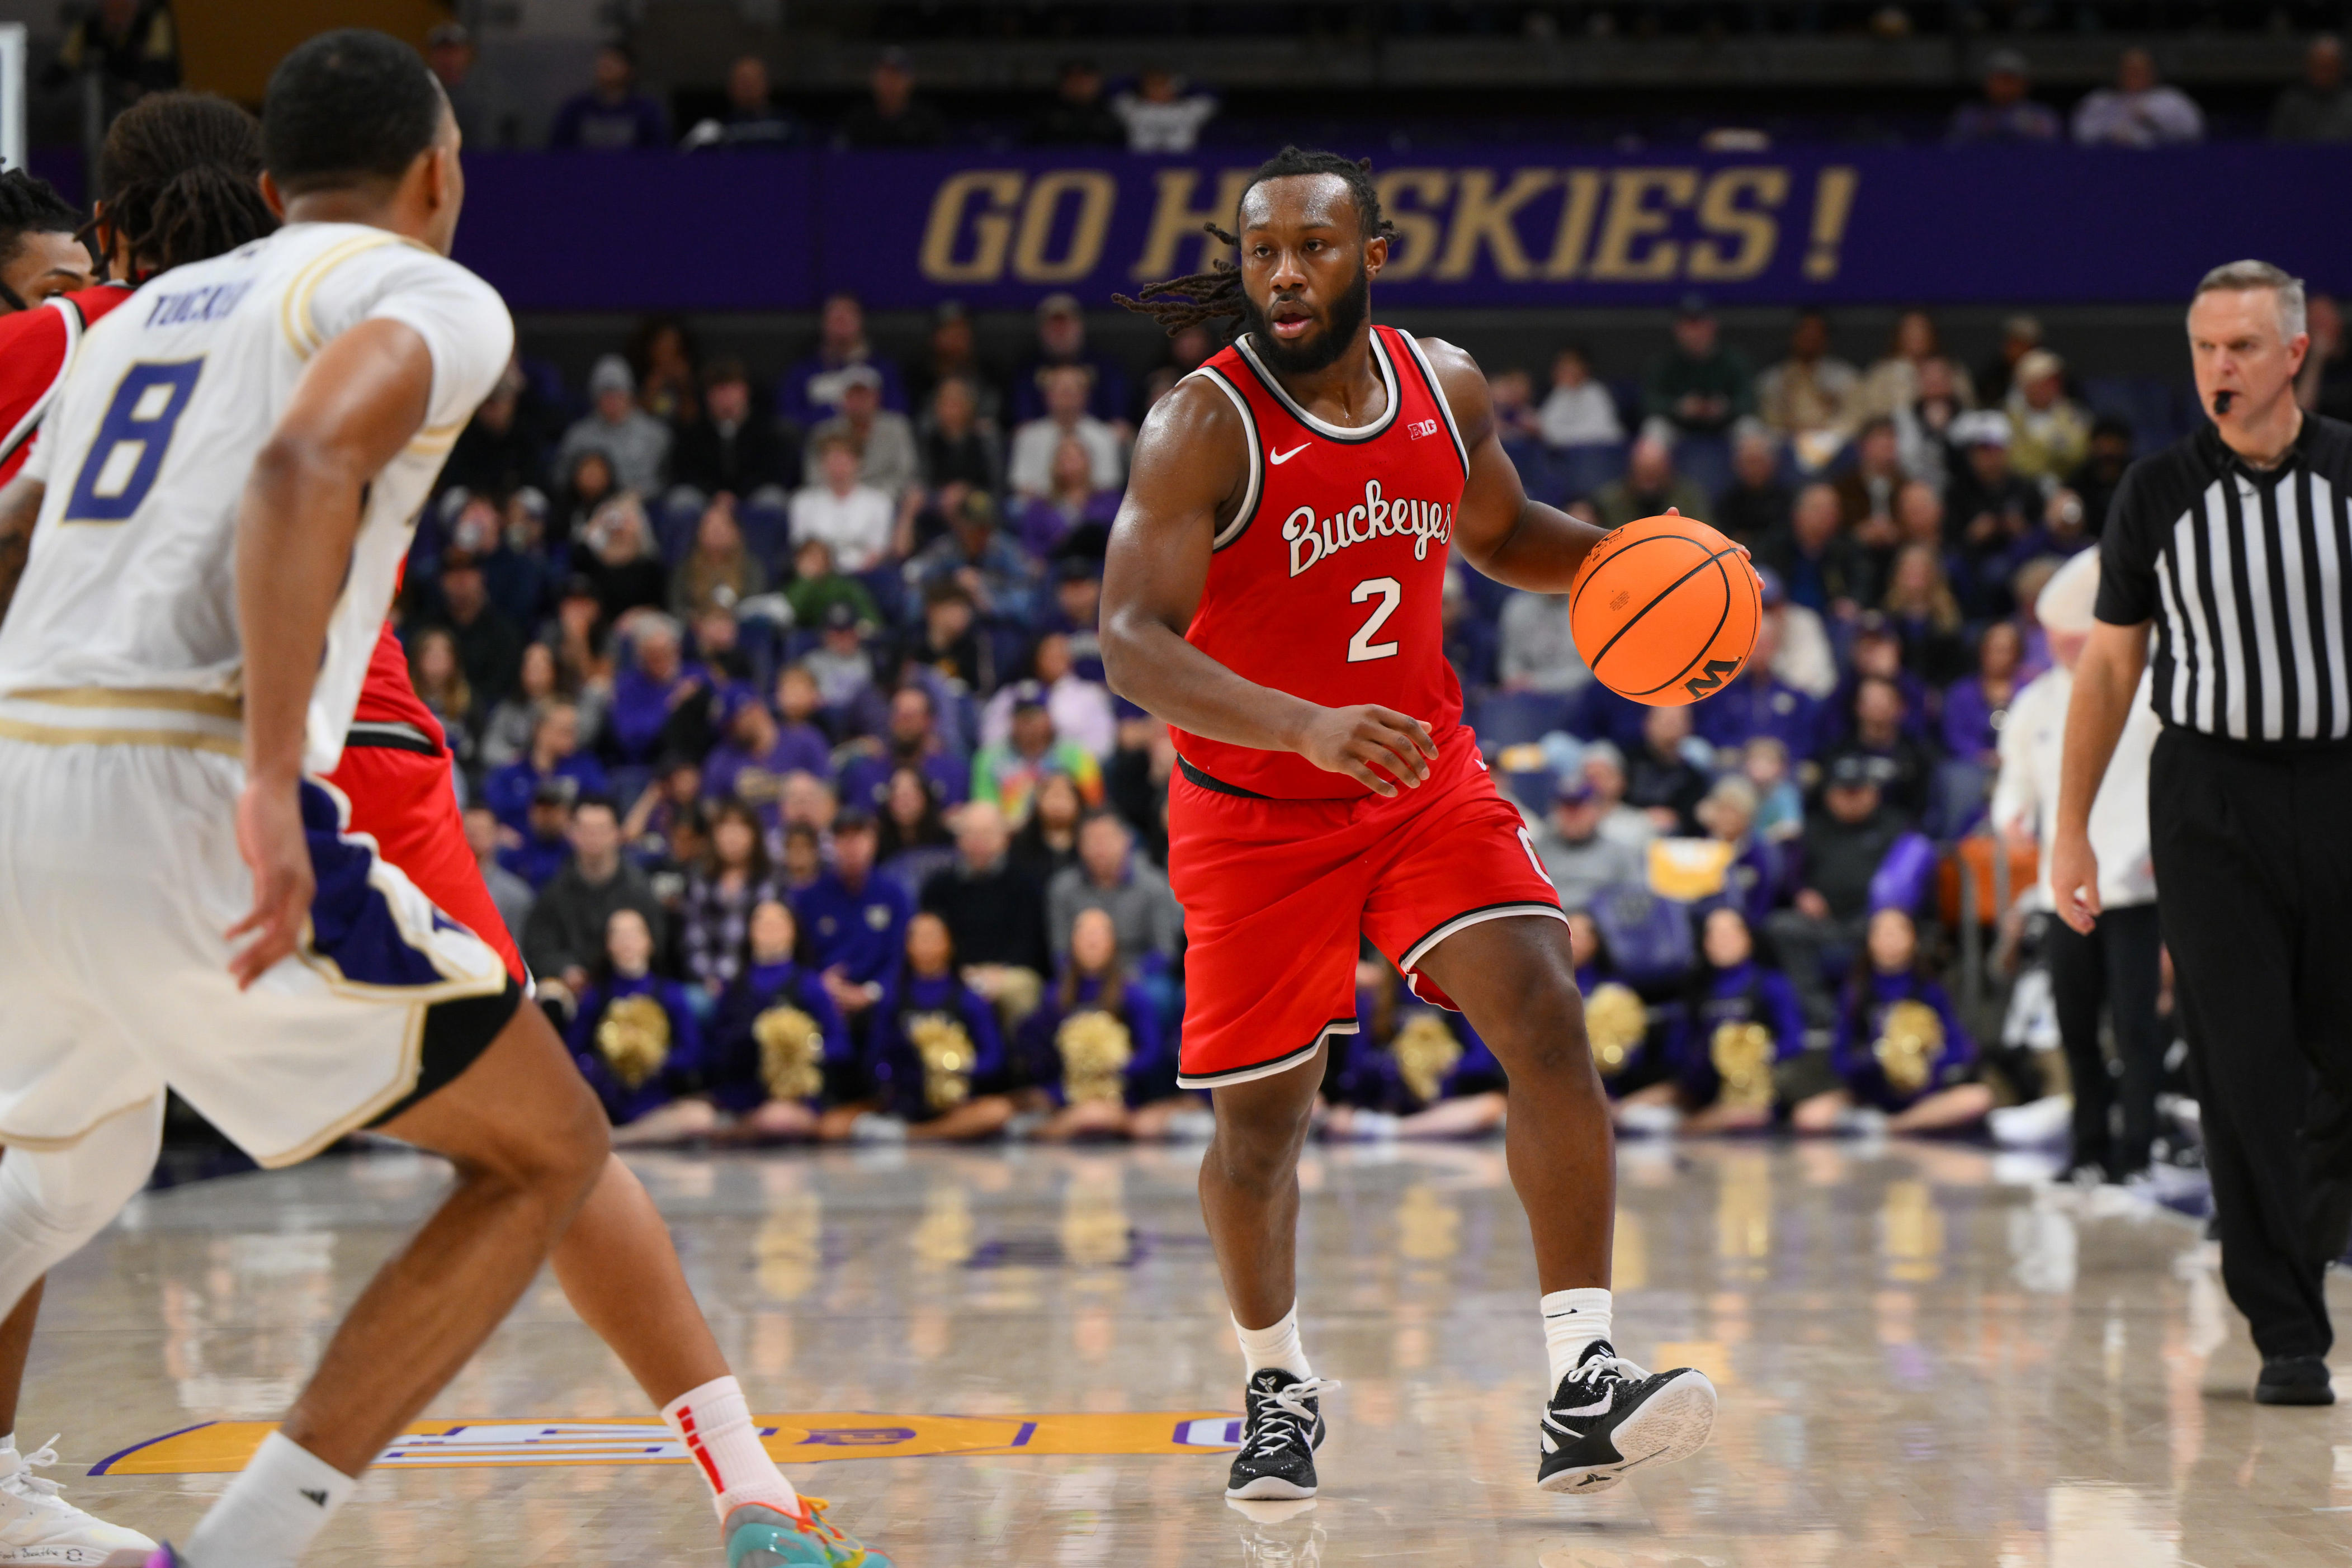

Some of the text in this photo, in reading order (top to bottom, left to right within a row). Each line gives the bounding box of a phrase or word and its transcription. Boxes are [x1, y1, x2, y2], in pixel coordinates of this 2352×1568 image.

[918, 169, 1118, 284] GO
[58, 351, 209, 527] 8
[1282, 479, 1452, 578] Buckeyes
[1347, 576, 1401, 663] 2
